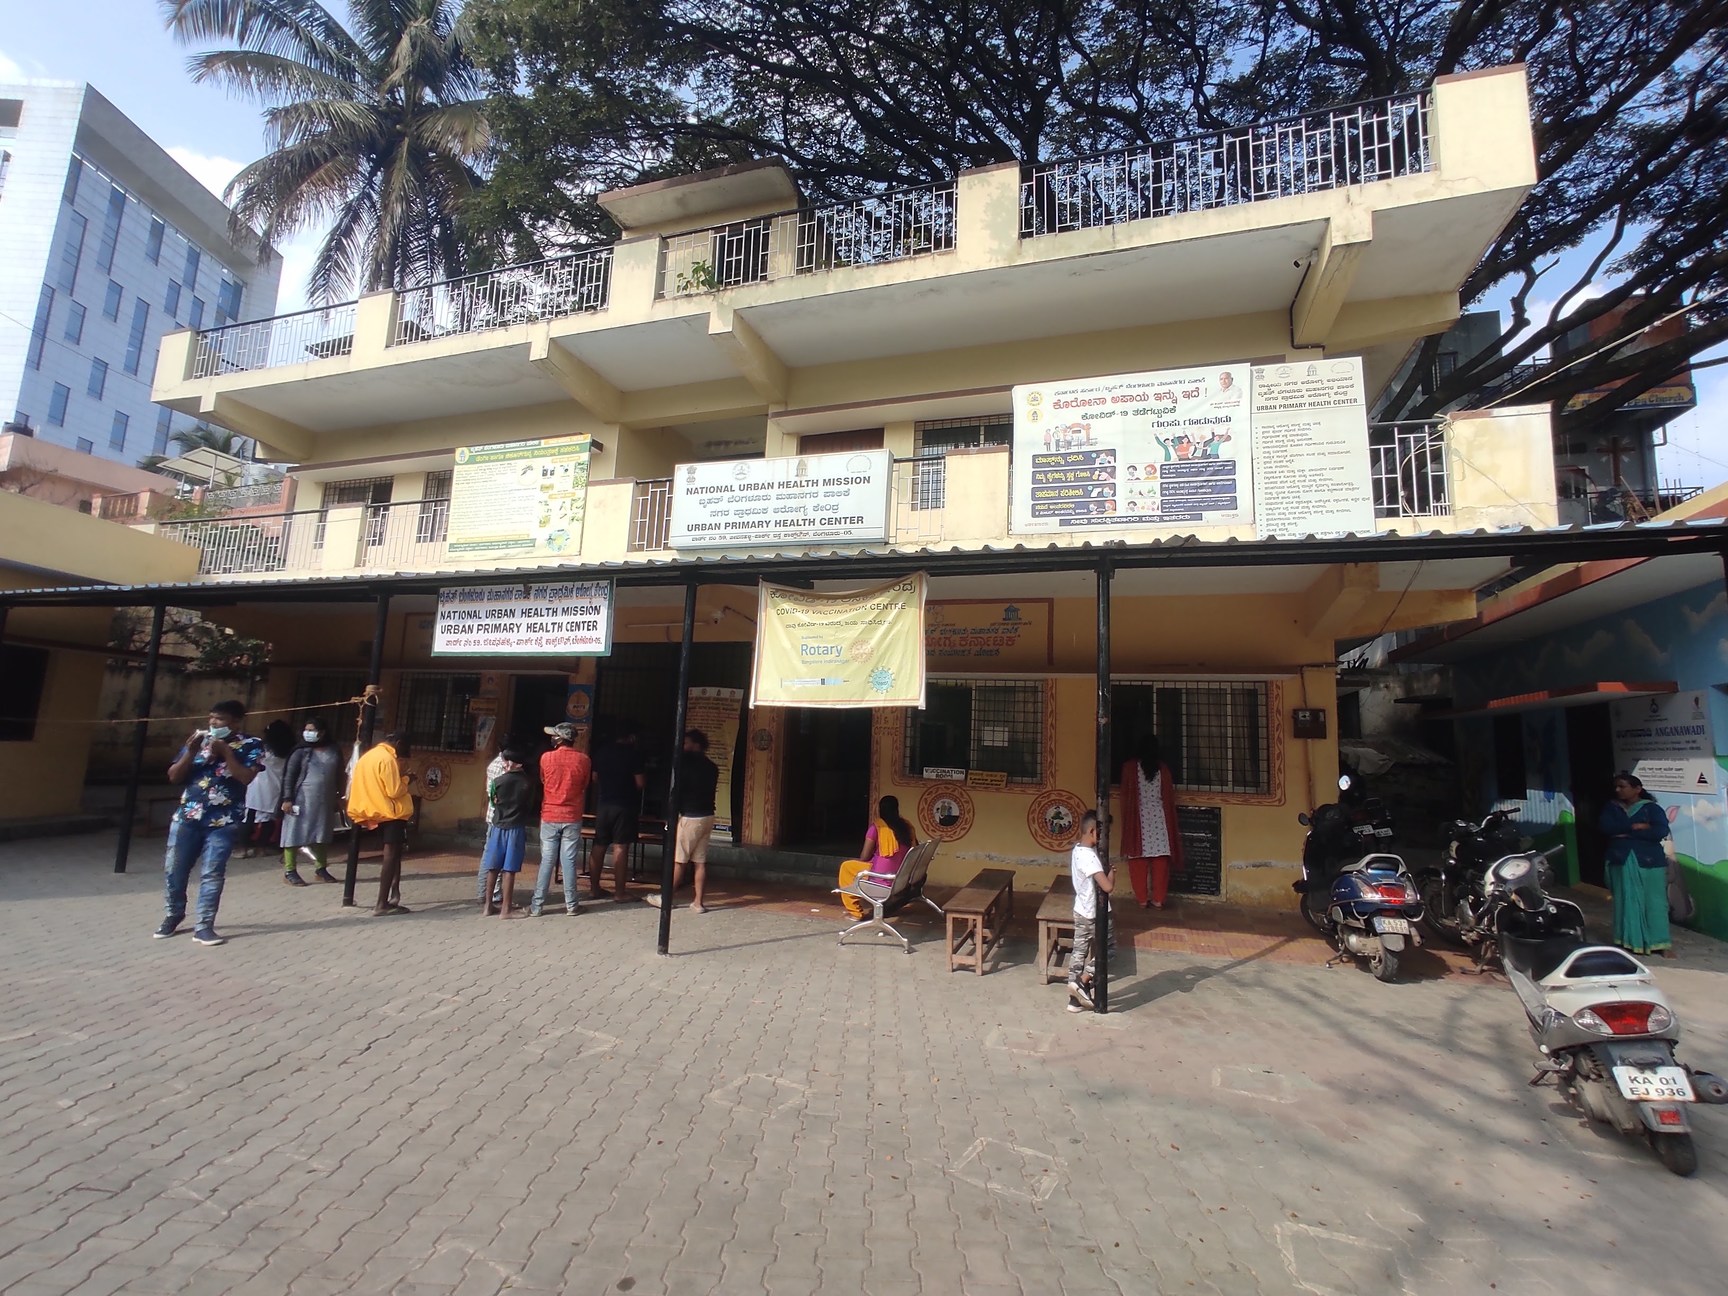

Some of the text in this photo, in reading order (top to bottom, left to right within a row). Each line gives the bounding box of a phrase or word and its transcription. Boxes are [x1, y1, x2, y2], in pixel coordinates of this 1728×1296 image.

[1110, 394, 1150, 404] ಅಪಾಯ
[1153, 389, 1178, 404] ಇನ್ನು
[1181, 386, 1200, 400] ಇದೆ
[1308, 400, 1332, 408] HEALTH
[1333, 398, 1358, 406] CENTER
[686, 476, 870, 496] NATIONAL URBAN HEALTH MISSION
[728, 495, 772, 504] ಬೆಂಗಳೂರು
[776, 492, 818, 500] ಮಹಾನಗರ
[710, 510, 730, 518] ನಗರ
[686, 516, 864, 532] URBAN PRIMARY HEALTH CENTER
[440, 605, 602, 620] NATIONAL URBAN HEALTH MISSION
[776, 608, 810, 616] COVID-19
[812, 604, 868, 616] VACCINATION
[440, 620, 598, 634] URBAN PRIMARY HEALTH CENTER
[800, 644, 843, 657] Rotary
[1654, 725, 1705, 736] ANGANAWADI
[1628, 1075, 1677, 1086] KA 01
[1628, 1087, 1686, 1097] EJ 936
